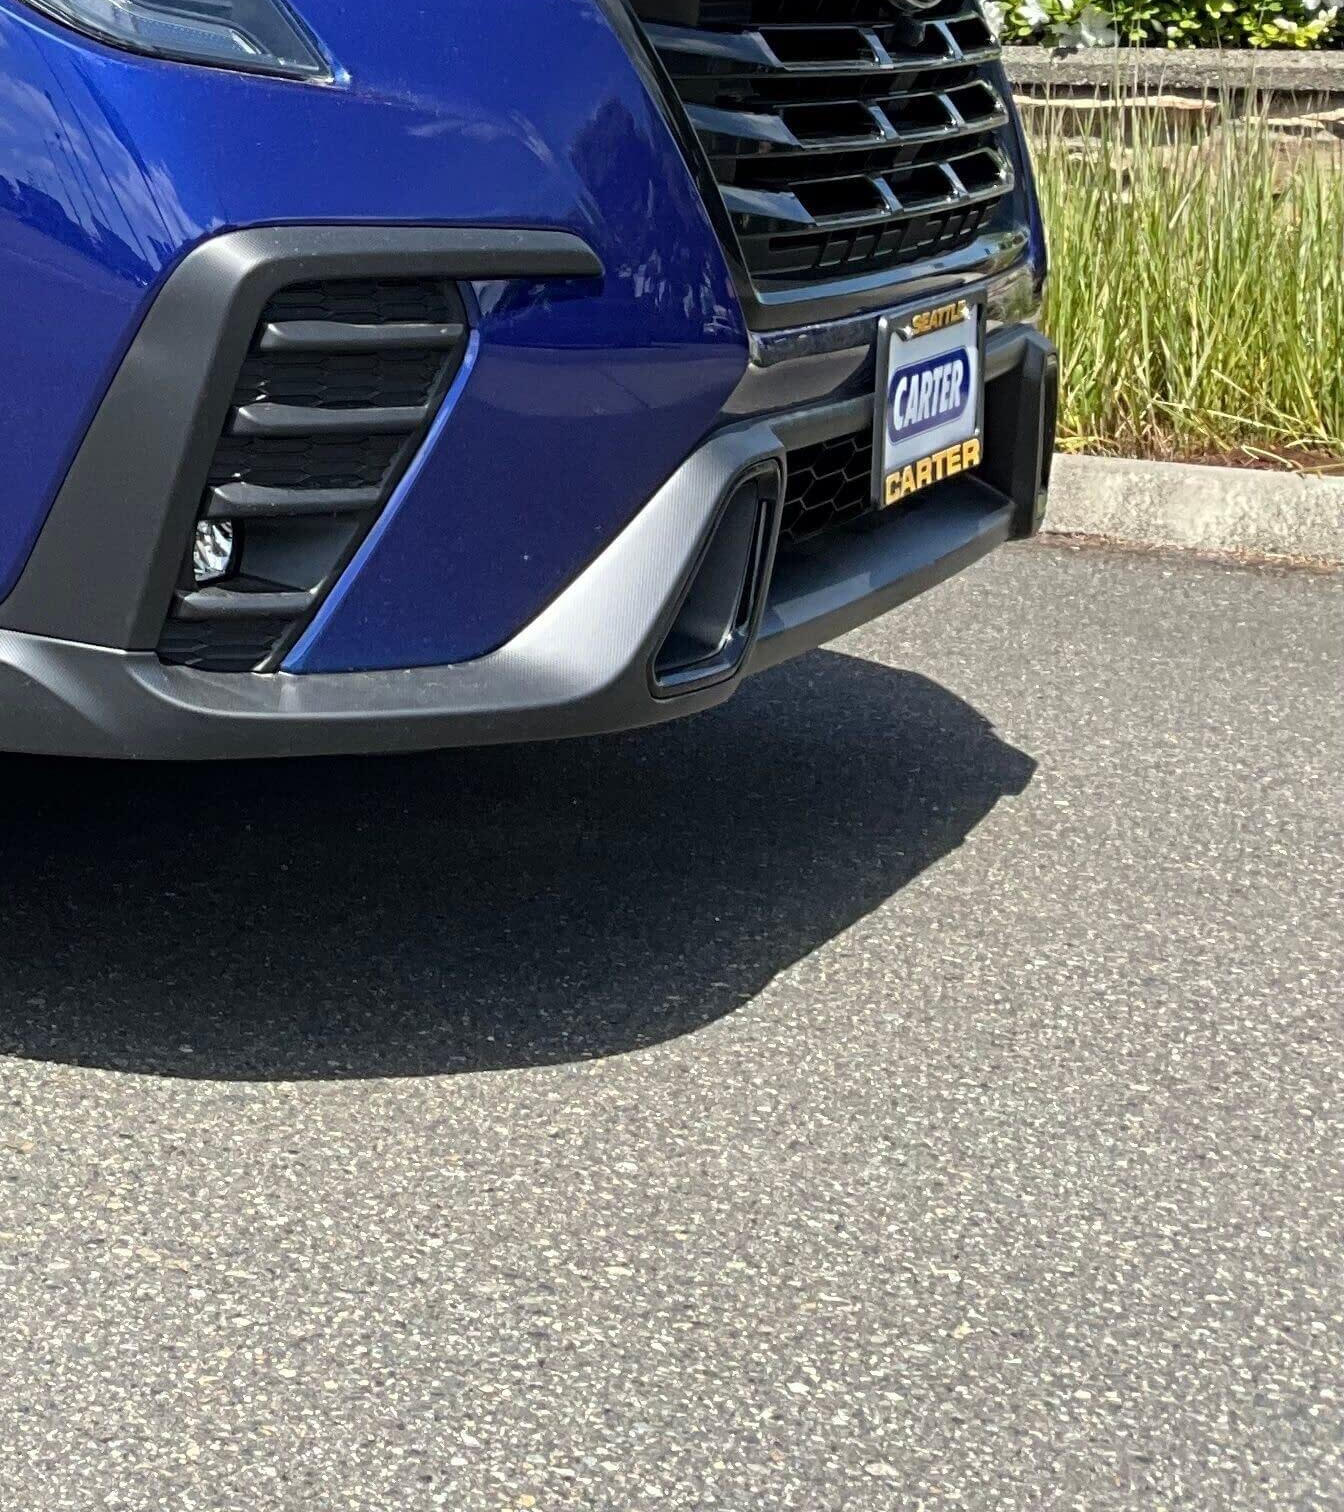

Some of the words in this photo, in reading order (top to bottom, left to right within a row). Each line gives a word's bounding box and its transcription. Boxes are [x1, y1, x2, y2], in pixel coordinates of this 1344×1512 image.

[912, 299, 968, 335] SEATTLE
[893, 360, 964, 431] CARTER
[885, 438, 980, 505] CARTER
